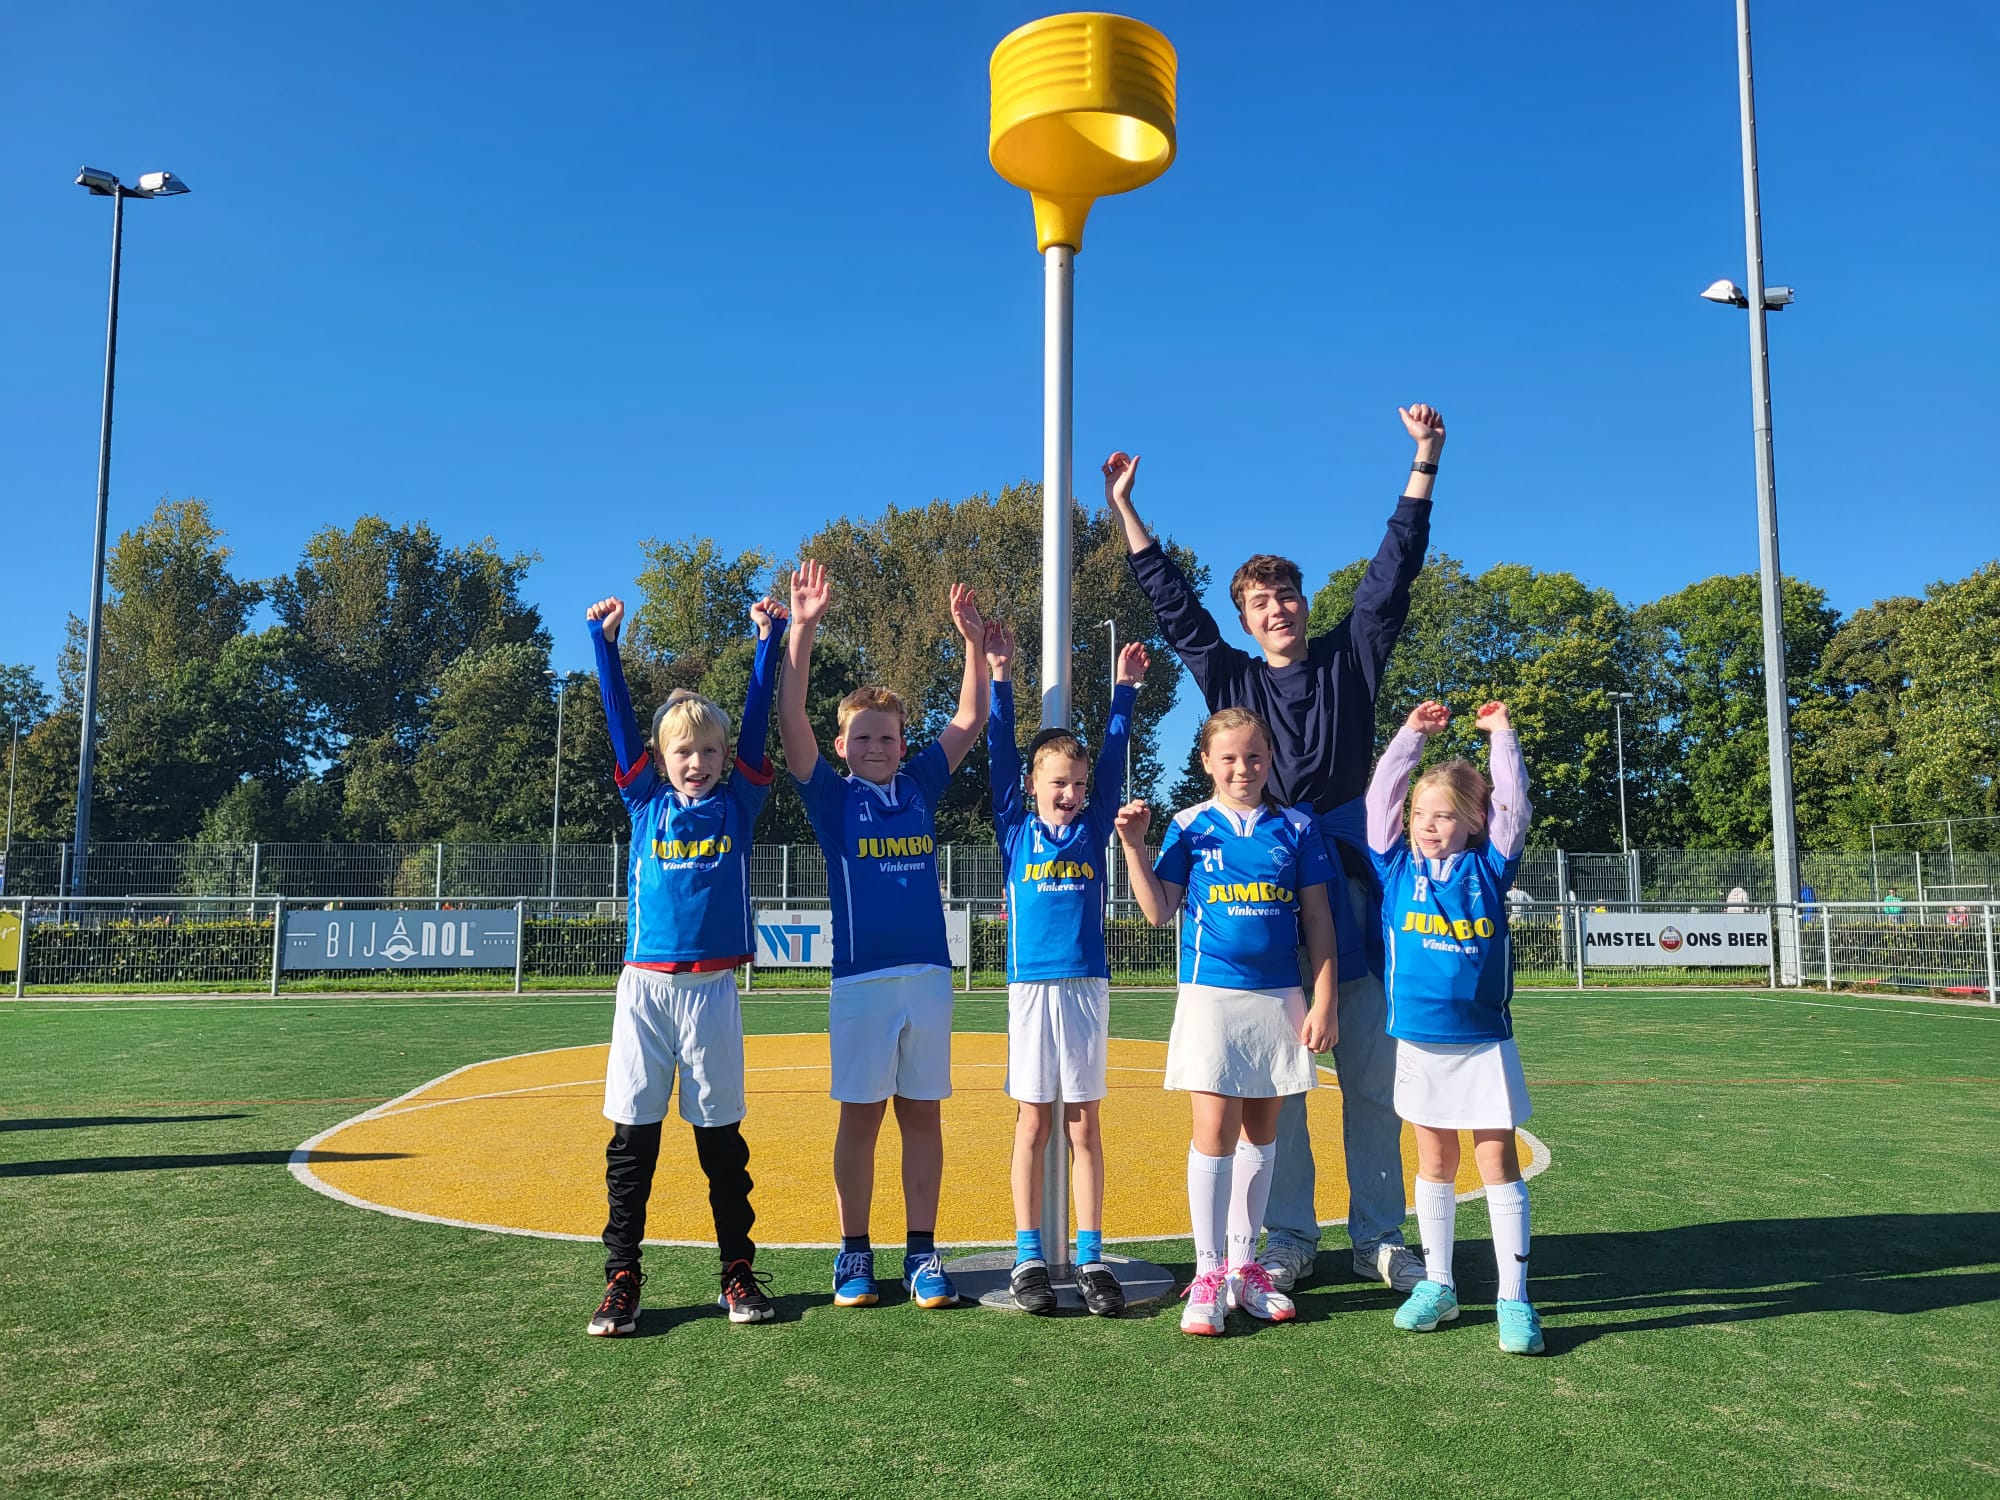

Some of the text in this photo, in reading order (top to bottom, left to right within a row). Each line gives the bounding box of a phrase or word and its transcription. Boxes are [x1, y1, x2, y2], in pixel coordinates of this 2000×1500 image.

[649, 835, 732, 860] JUMBO
[855, 834, 934, 858] JUMBO
[879, 862, 926, 872] Vinkeveen
[1021, 860, 1095, 882] JUMBO
[1201, 848, 1224, 872] 24
[1037, 882, 1085, 892] Vinkeveen
[1206, 881, 1294, 904] JUMBO
[1227, 905, 1280, 916] Vinkeveen
[1401, 911, 1495, 940] JUMBO
[326, 921, 376, 957] BIJ
[1422, 939, 1479, 954] Vinkeven
[1585, 932, 1768, 947] AMSTEL ONS BIER
